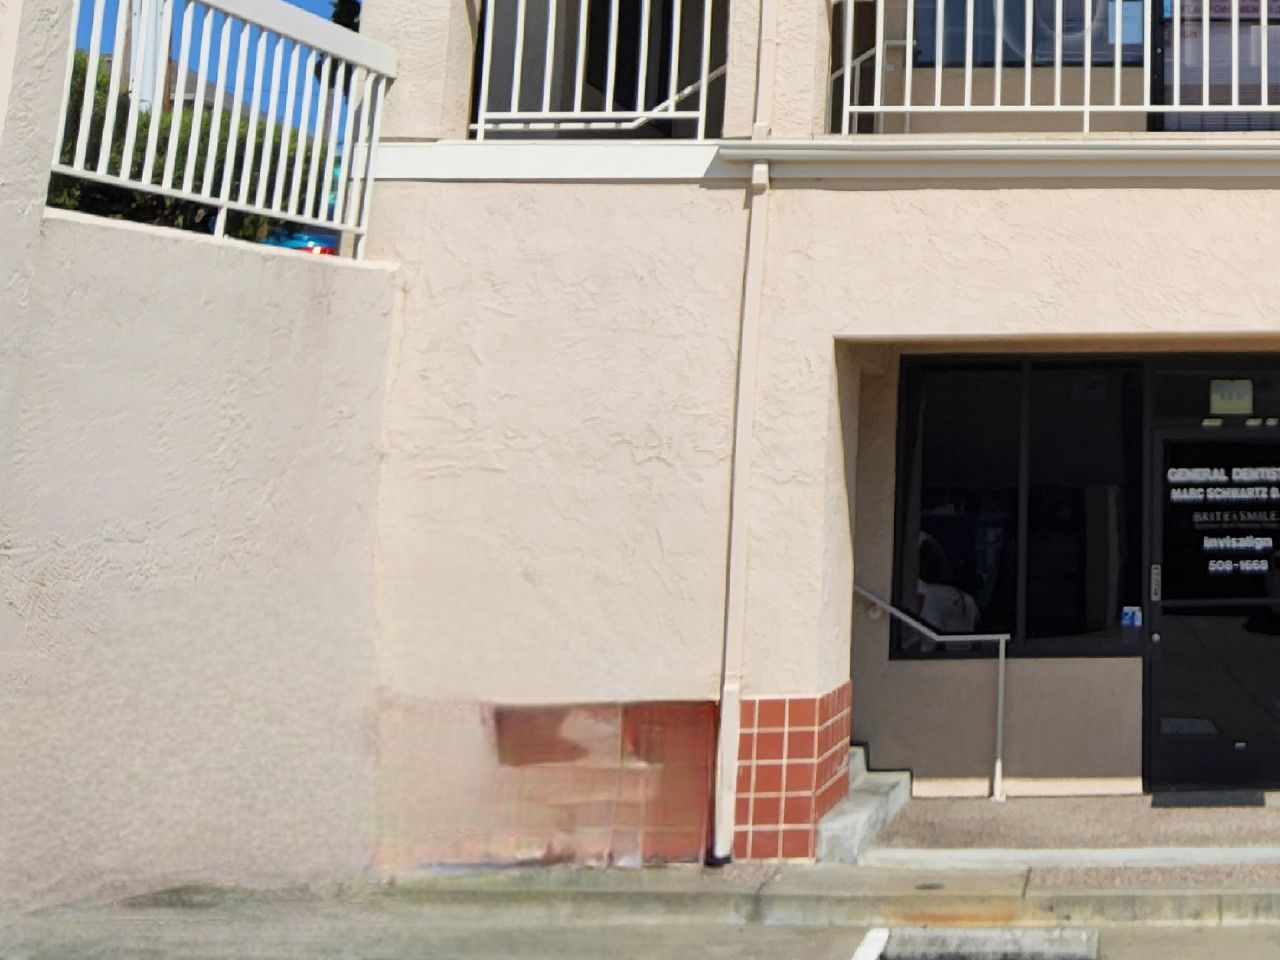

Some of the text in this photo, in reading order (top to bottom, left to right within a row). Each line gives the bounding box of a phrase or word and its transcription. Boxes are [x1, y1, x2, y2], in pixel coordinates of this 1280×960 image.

[1167, 467, 1229, 482] GENERAL
[1170, 487, 1204, 500] MARC
[1206, 487, 1268, 500] SCHWARTZ
